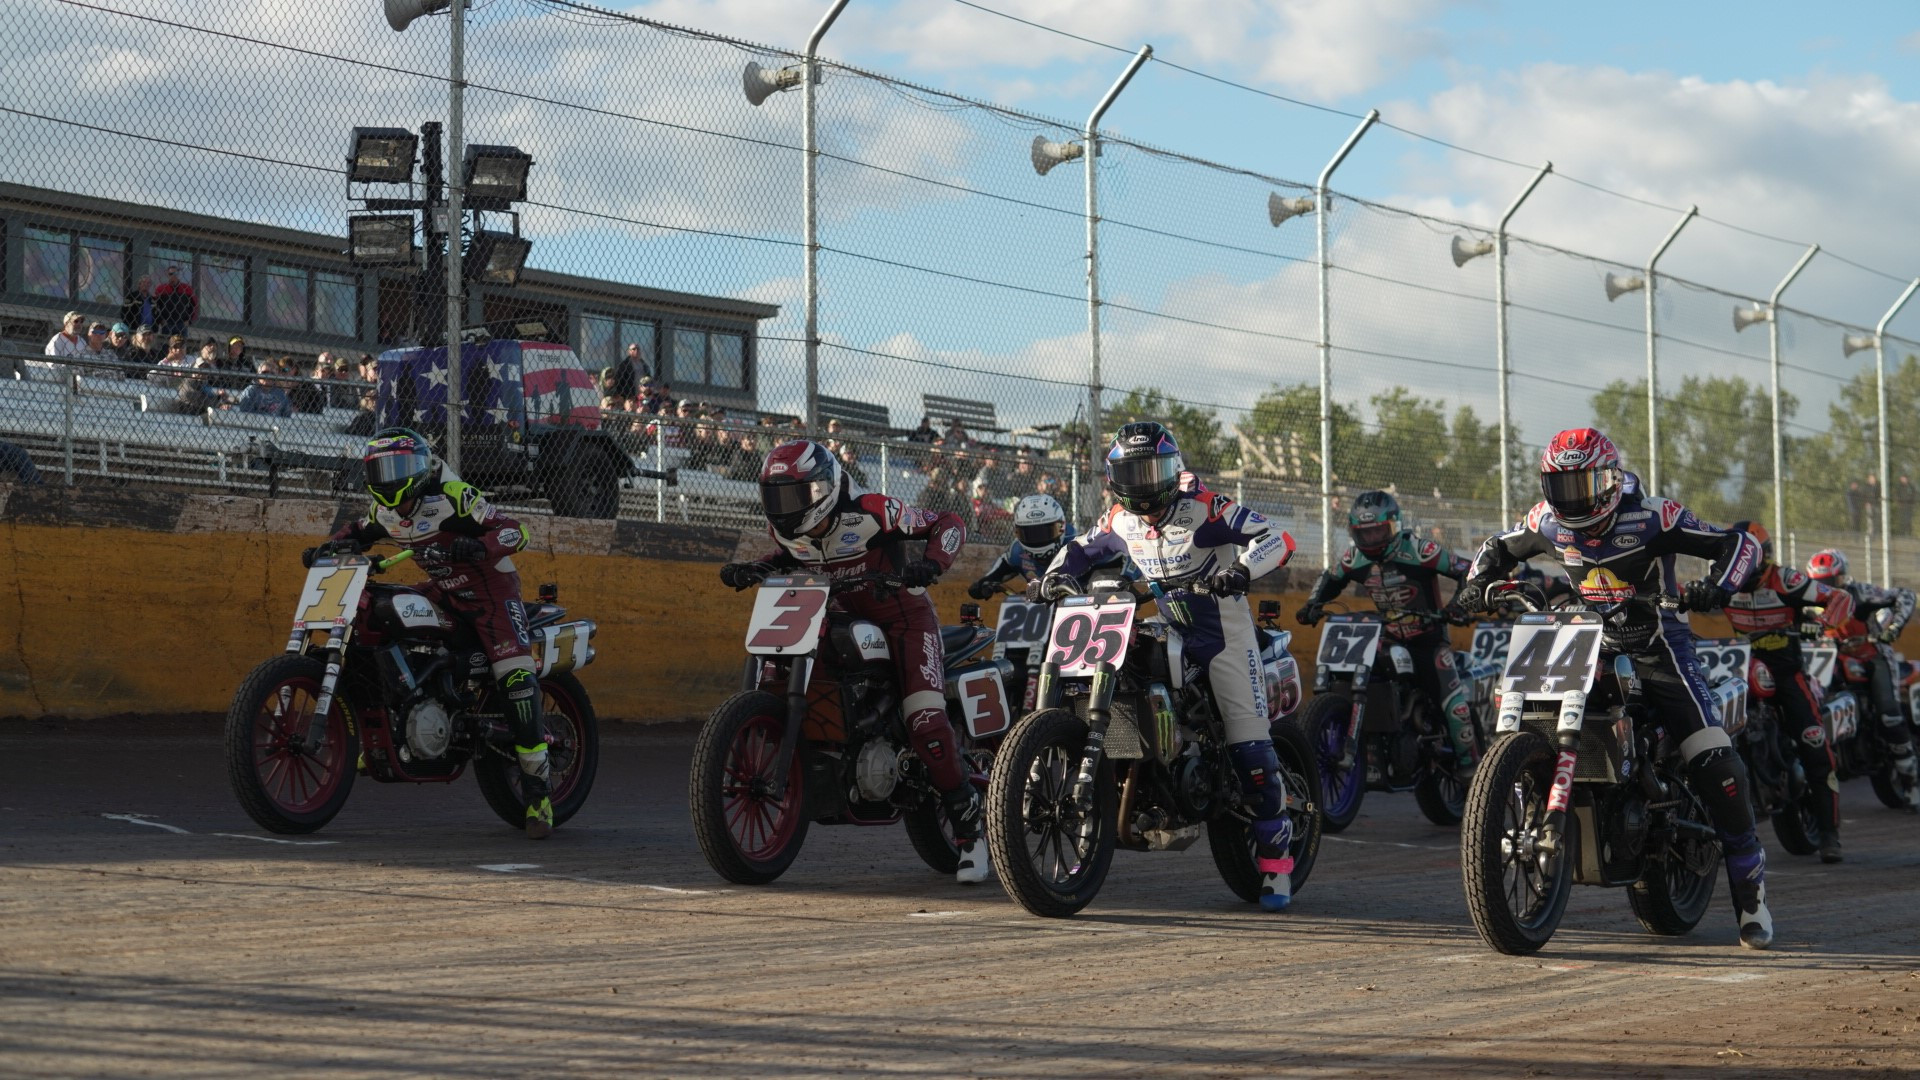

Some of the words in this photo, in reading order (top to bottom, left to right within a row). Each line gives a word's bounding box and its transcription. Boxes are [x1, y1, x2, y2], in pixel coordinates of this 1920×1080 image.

[1561, 452, 1583, 460] Arai
[1249, 537, 1281, 559] ESTENSON
[1618, 535, 1635, 545] Arai
[1731, 543, 1755, 587] SENA
[301, 567, 357, 622] 1
[402, 603, 433, 619] Indian
[511, 601, 529, 643] Corbin
[748, 590, 826, 647] 3
[997, 605, 1050, 642] 20
[1052, 607, 1131, 669] 95
[552, 625, 575, 672] 1
[862, 634, 885, 650] Indian
[1319, 625, 1379, 663] 67
[1474, 631, 1512, 659] 92
[1506, 629, 1600, 693] 44
[1247, 649, 1264, 717] ESTENSON
[336, 696, 356, 737] DUNLOP
[966, 677, 1006, 735] 3
[1549, 751, 1576, 808] MOLY
